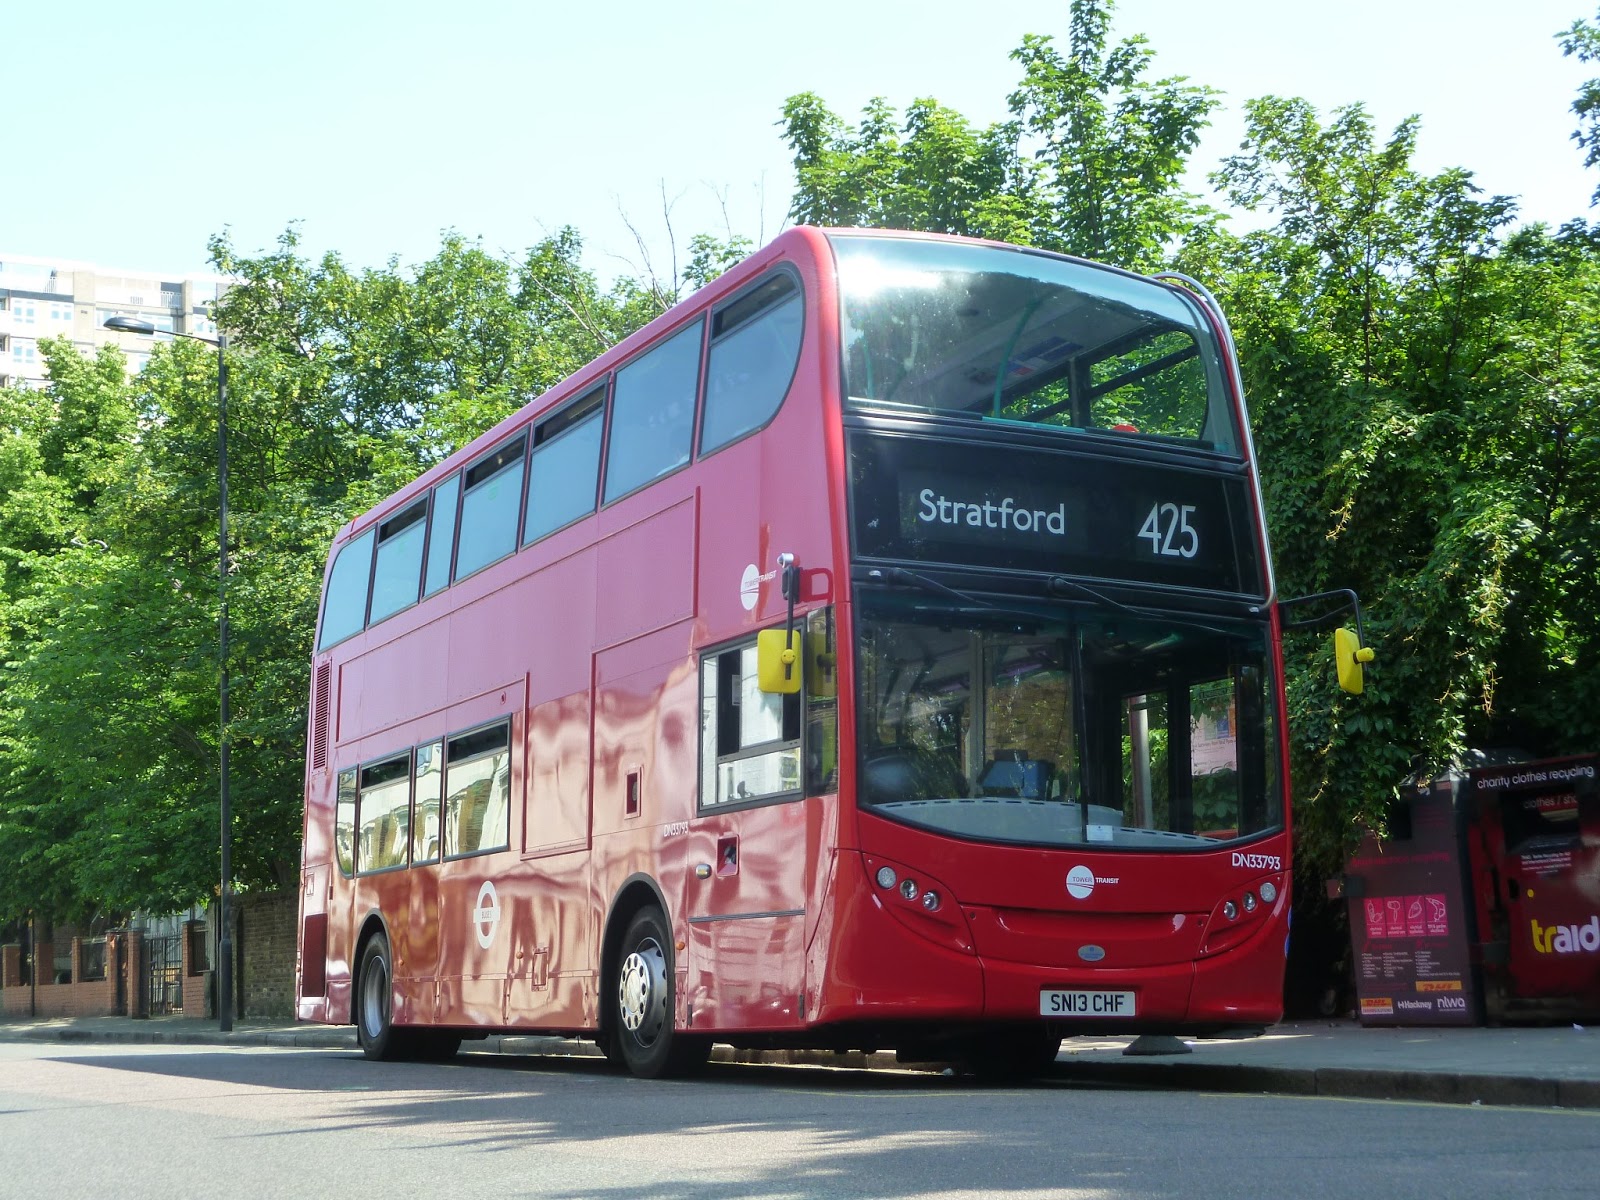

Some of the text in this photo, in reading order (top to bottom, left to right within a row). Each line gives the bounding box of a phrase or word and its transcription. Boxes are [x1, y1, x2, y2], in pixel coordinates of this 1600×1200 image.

[919, 488, 1199, 559] Stratford 425
[1477, 764, 1595, 789] charity clothes recycling
[663, 821, 689, 837] DN33793
[1232, 852, 1281, 871] DN33793
[1531, 915, 1600, 953] traid
[1050, 994, 1125, 1012] SN13 CHF
[1404, 1000, 1432, 1010] Hackney
[1437, 996, 1466, 1008] nlwa
